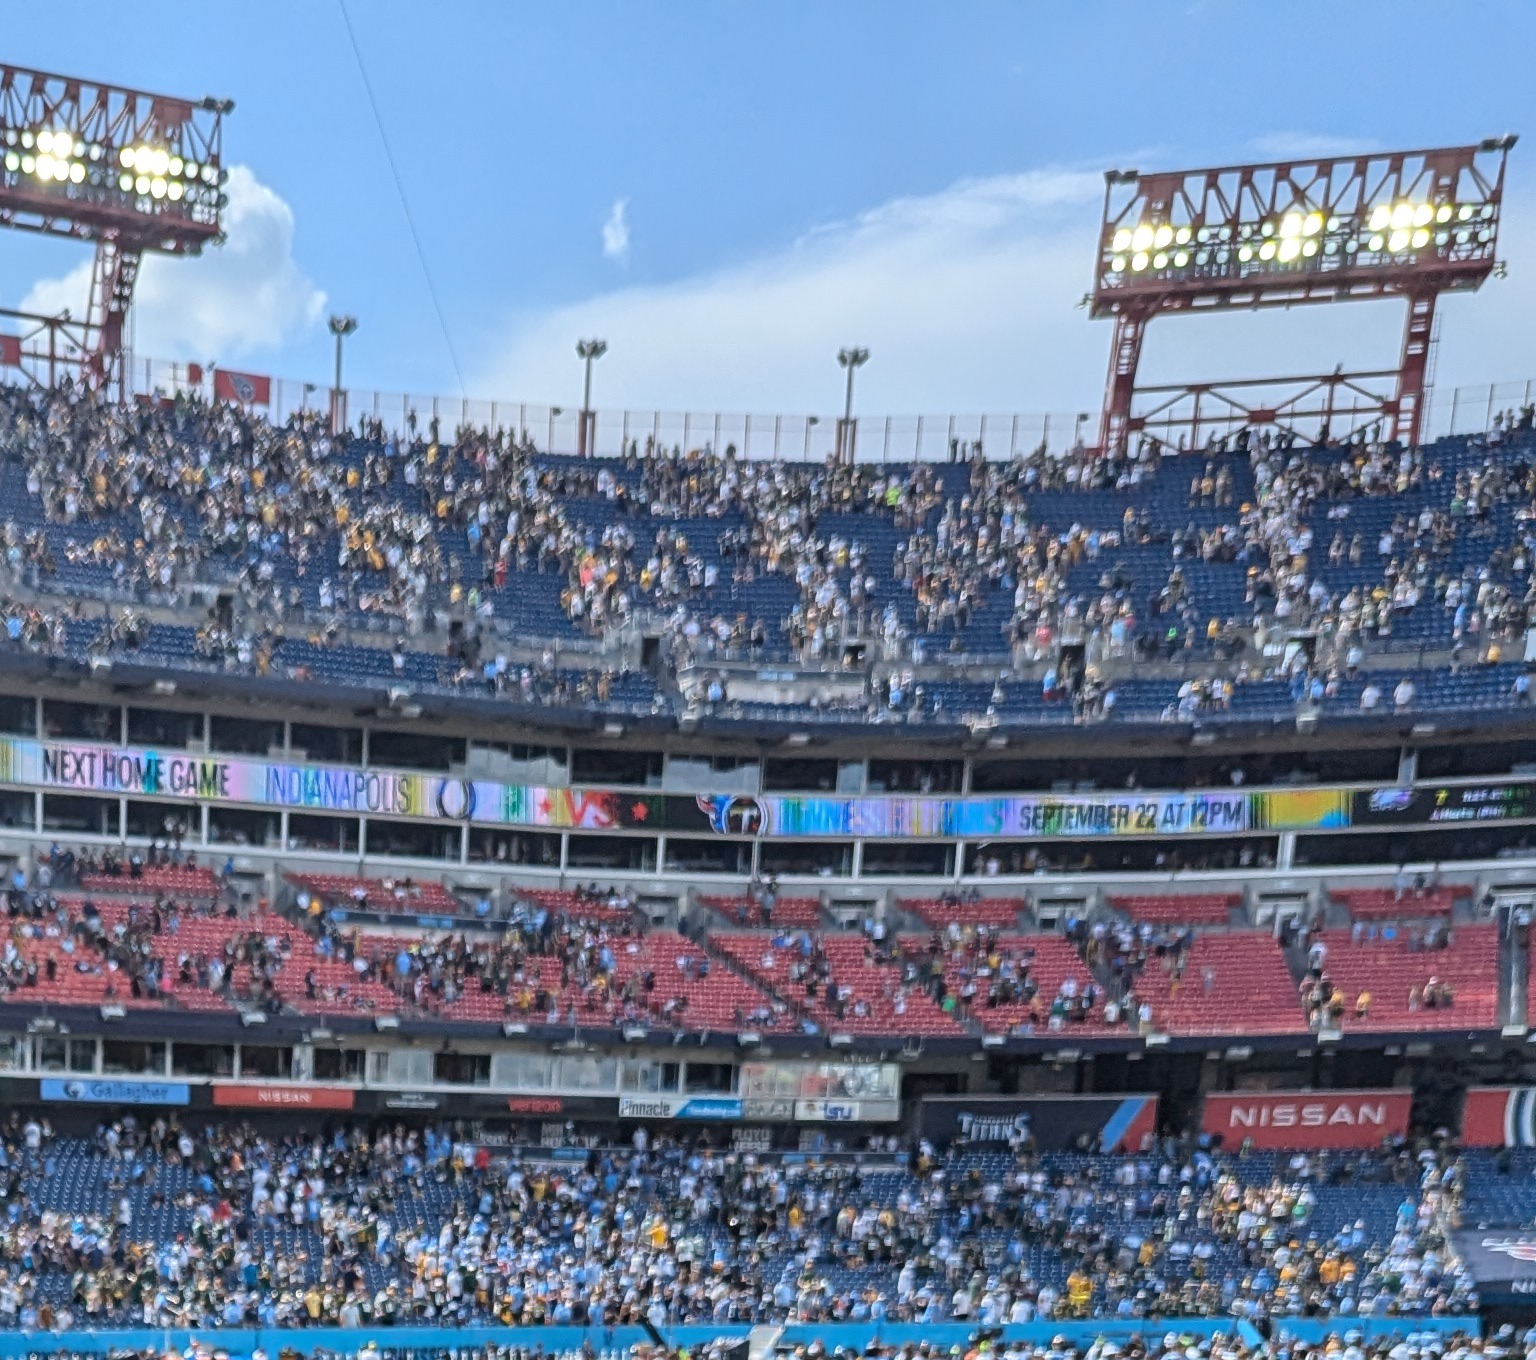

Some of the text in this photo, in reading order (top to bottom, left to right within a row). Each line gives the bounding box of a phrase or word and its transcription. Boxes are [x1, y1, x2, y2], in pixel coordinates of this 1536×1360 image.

[43, 750, 230, 797] NEXT HOME GAME
[267, 763, 411, 813] INDIANAPOLIS
[1020, 803, 1129, 830] SEPTEMBER
[1135, 803, 1158, 829] 22
[1162, 801, 1185, 827] AT
[92, 1083, 168, 1103] Gallagher
[258, 1089, 312, 1103] NISSAN
[620, 1097, 670, 1117] Pinnacle
[1229, 1103, 1386, 1127] NISSAN
